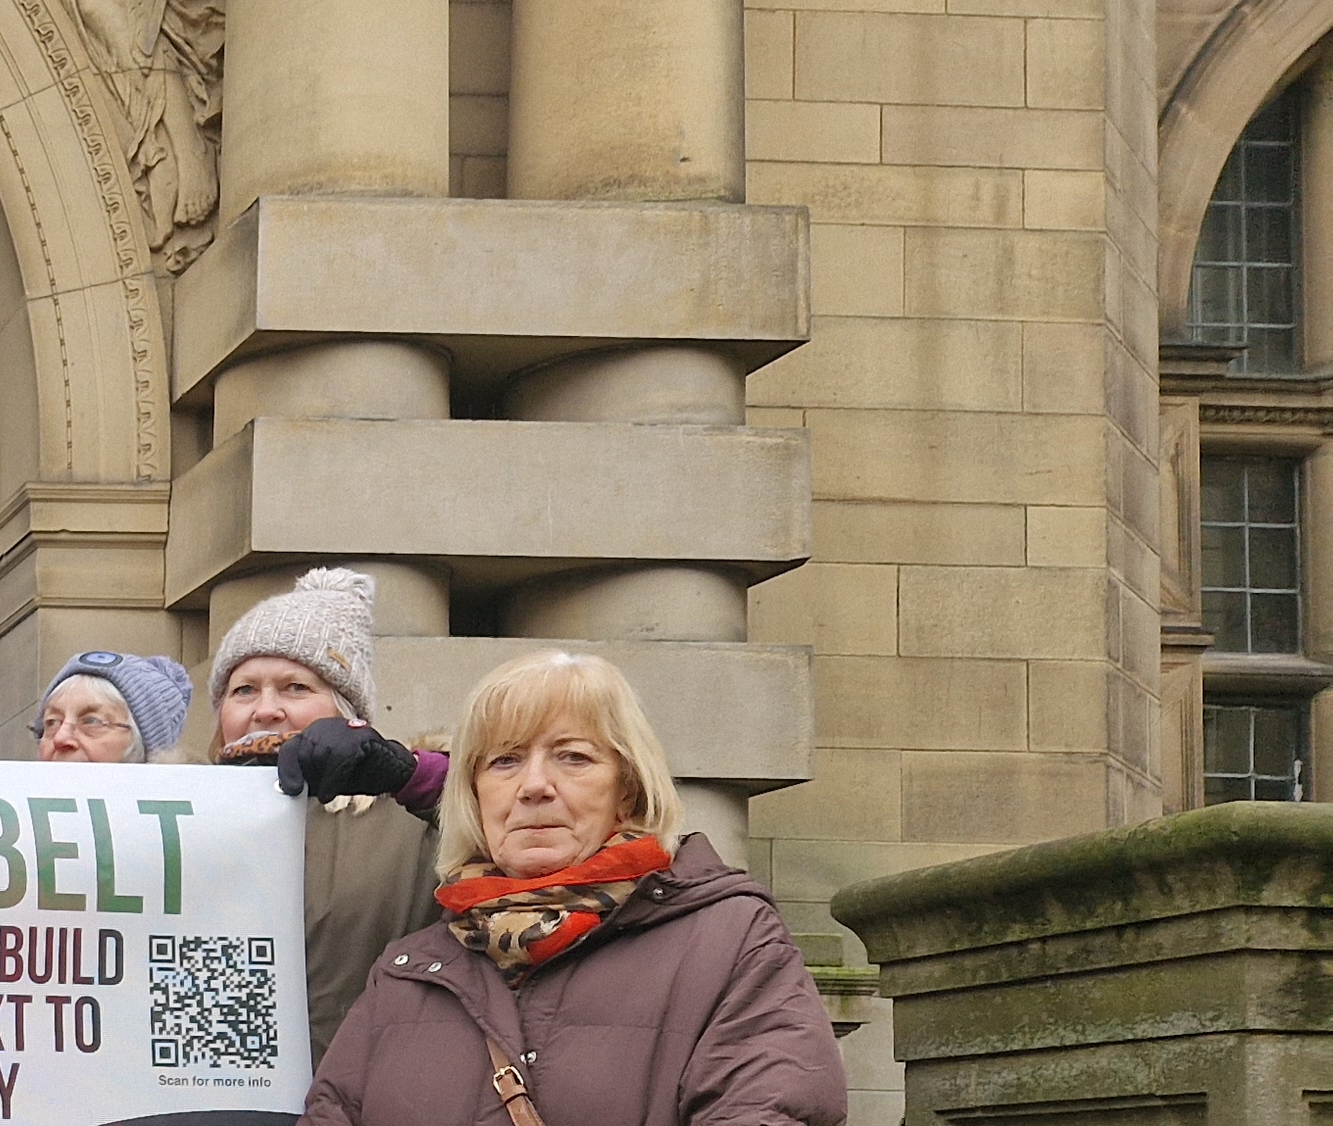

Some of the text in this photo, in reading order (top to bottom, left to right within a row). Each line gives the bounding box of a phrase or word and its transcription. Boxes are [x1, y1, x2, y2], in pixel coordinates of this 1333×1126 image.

[46, 994, 101, 1053] TO
[158, 1074, 272, 1088] Scan for more info
